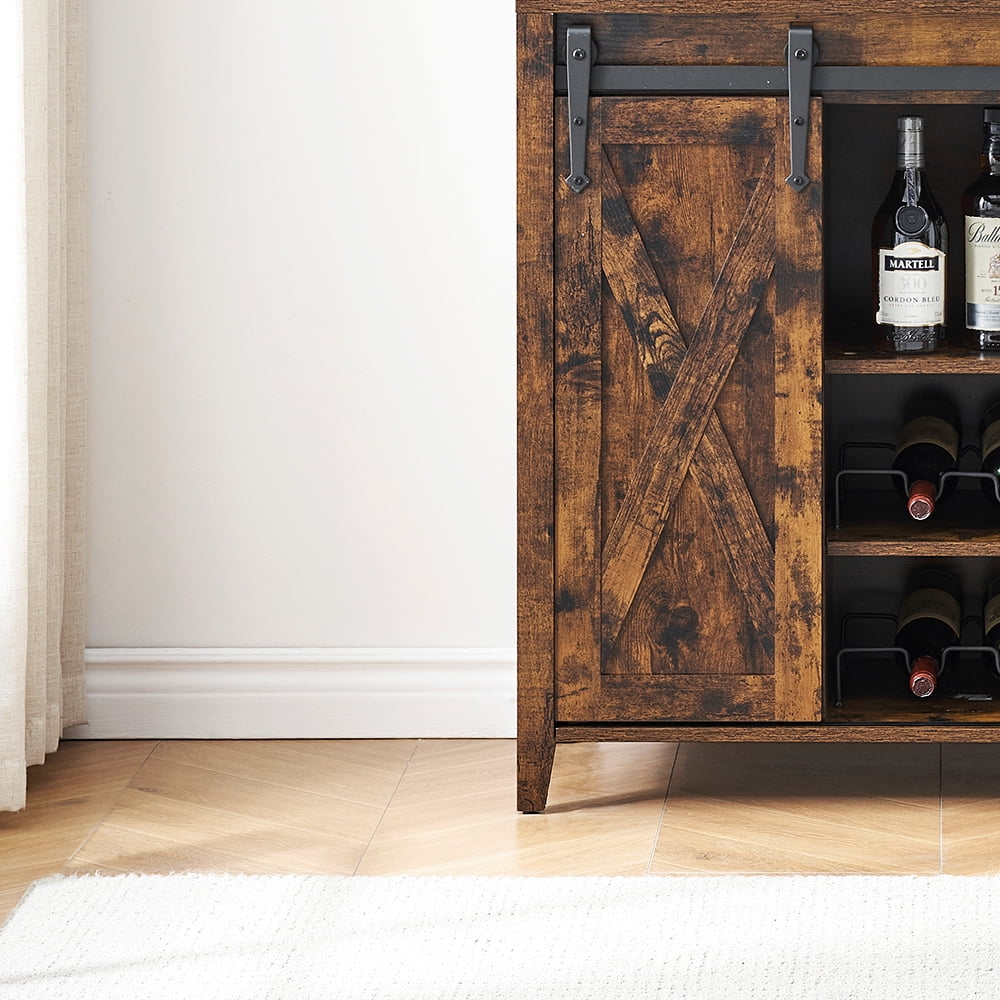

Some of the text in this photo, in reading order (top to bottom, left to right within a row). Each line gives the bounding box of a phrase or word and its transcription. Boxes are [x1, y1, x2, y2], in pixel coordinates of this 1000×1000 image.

[889, 259, 935, 269] MARTELL
[883, 295, 941, 303] CORDON BLEU
